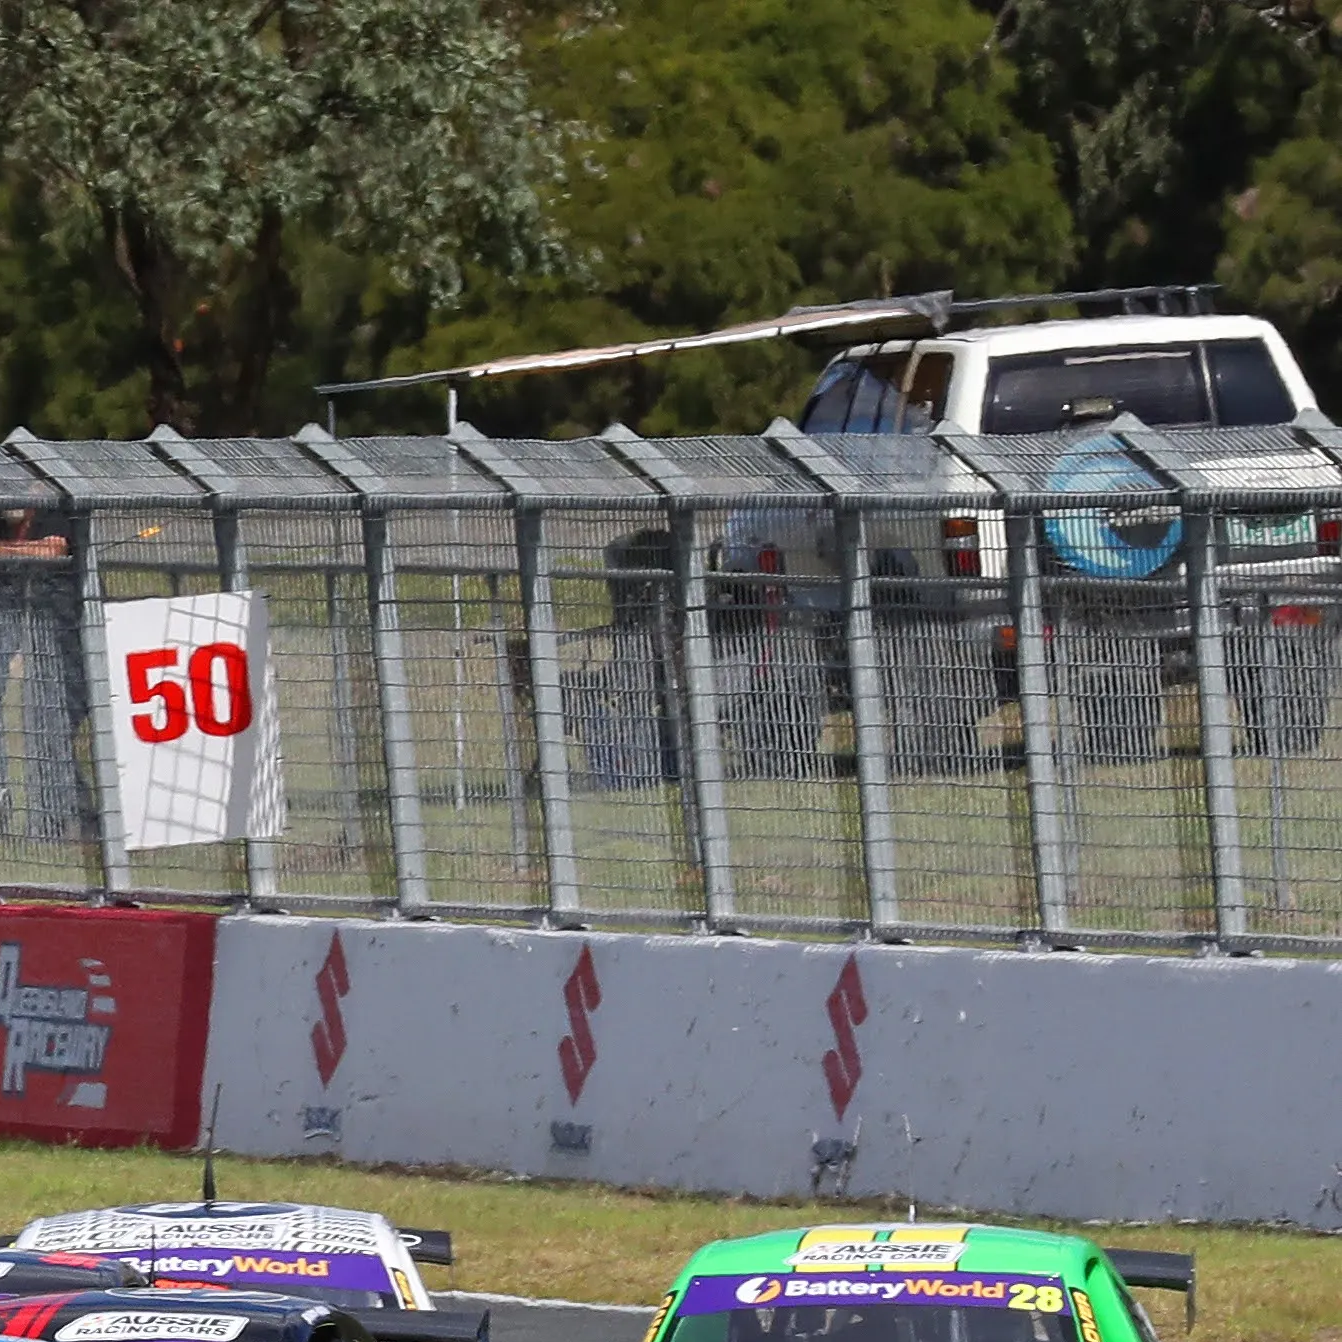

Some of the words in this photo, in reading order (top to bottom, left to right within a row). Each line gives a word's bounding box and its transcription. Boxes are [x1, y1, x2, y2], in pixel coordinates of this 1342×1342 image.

[125, 641, 253, 744] 50
[162, 1223, 276, 1233] AUSSIE
[833, 1242, 953, 1253] AUSSIE
[802, 1252, 884, 1262] RACING
[888, 1252, 948, 1262] CARS
[784, 1278, 1006, 1299] BatteryWorld
[1006, 1283, 1065, 1313] 28
[110, 1315, 238, 1327] AUSSIE
[75, 1325, 159, 1336] RACING
[166, 1325, 228, 1337] CARS
